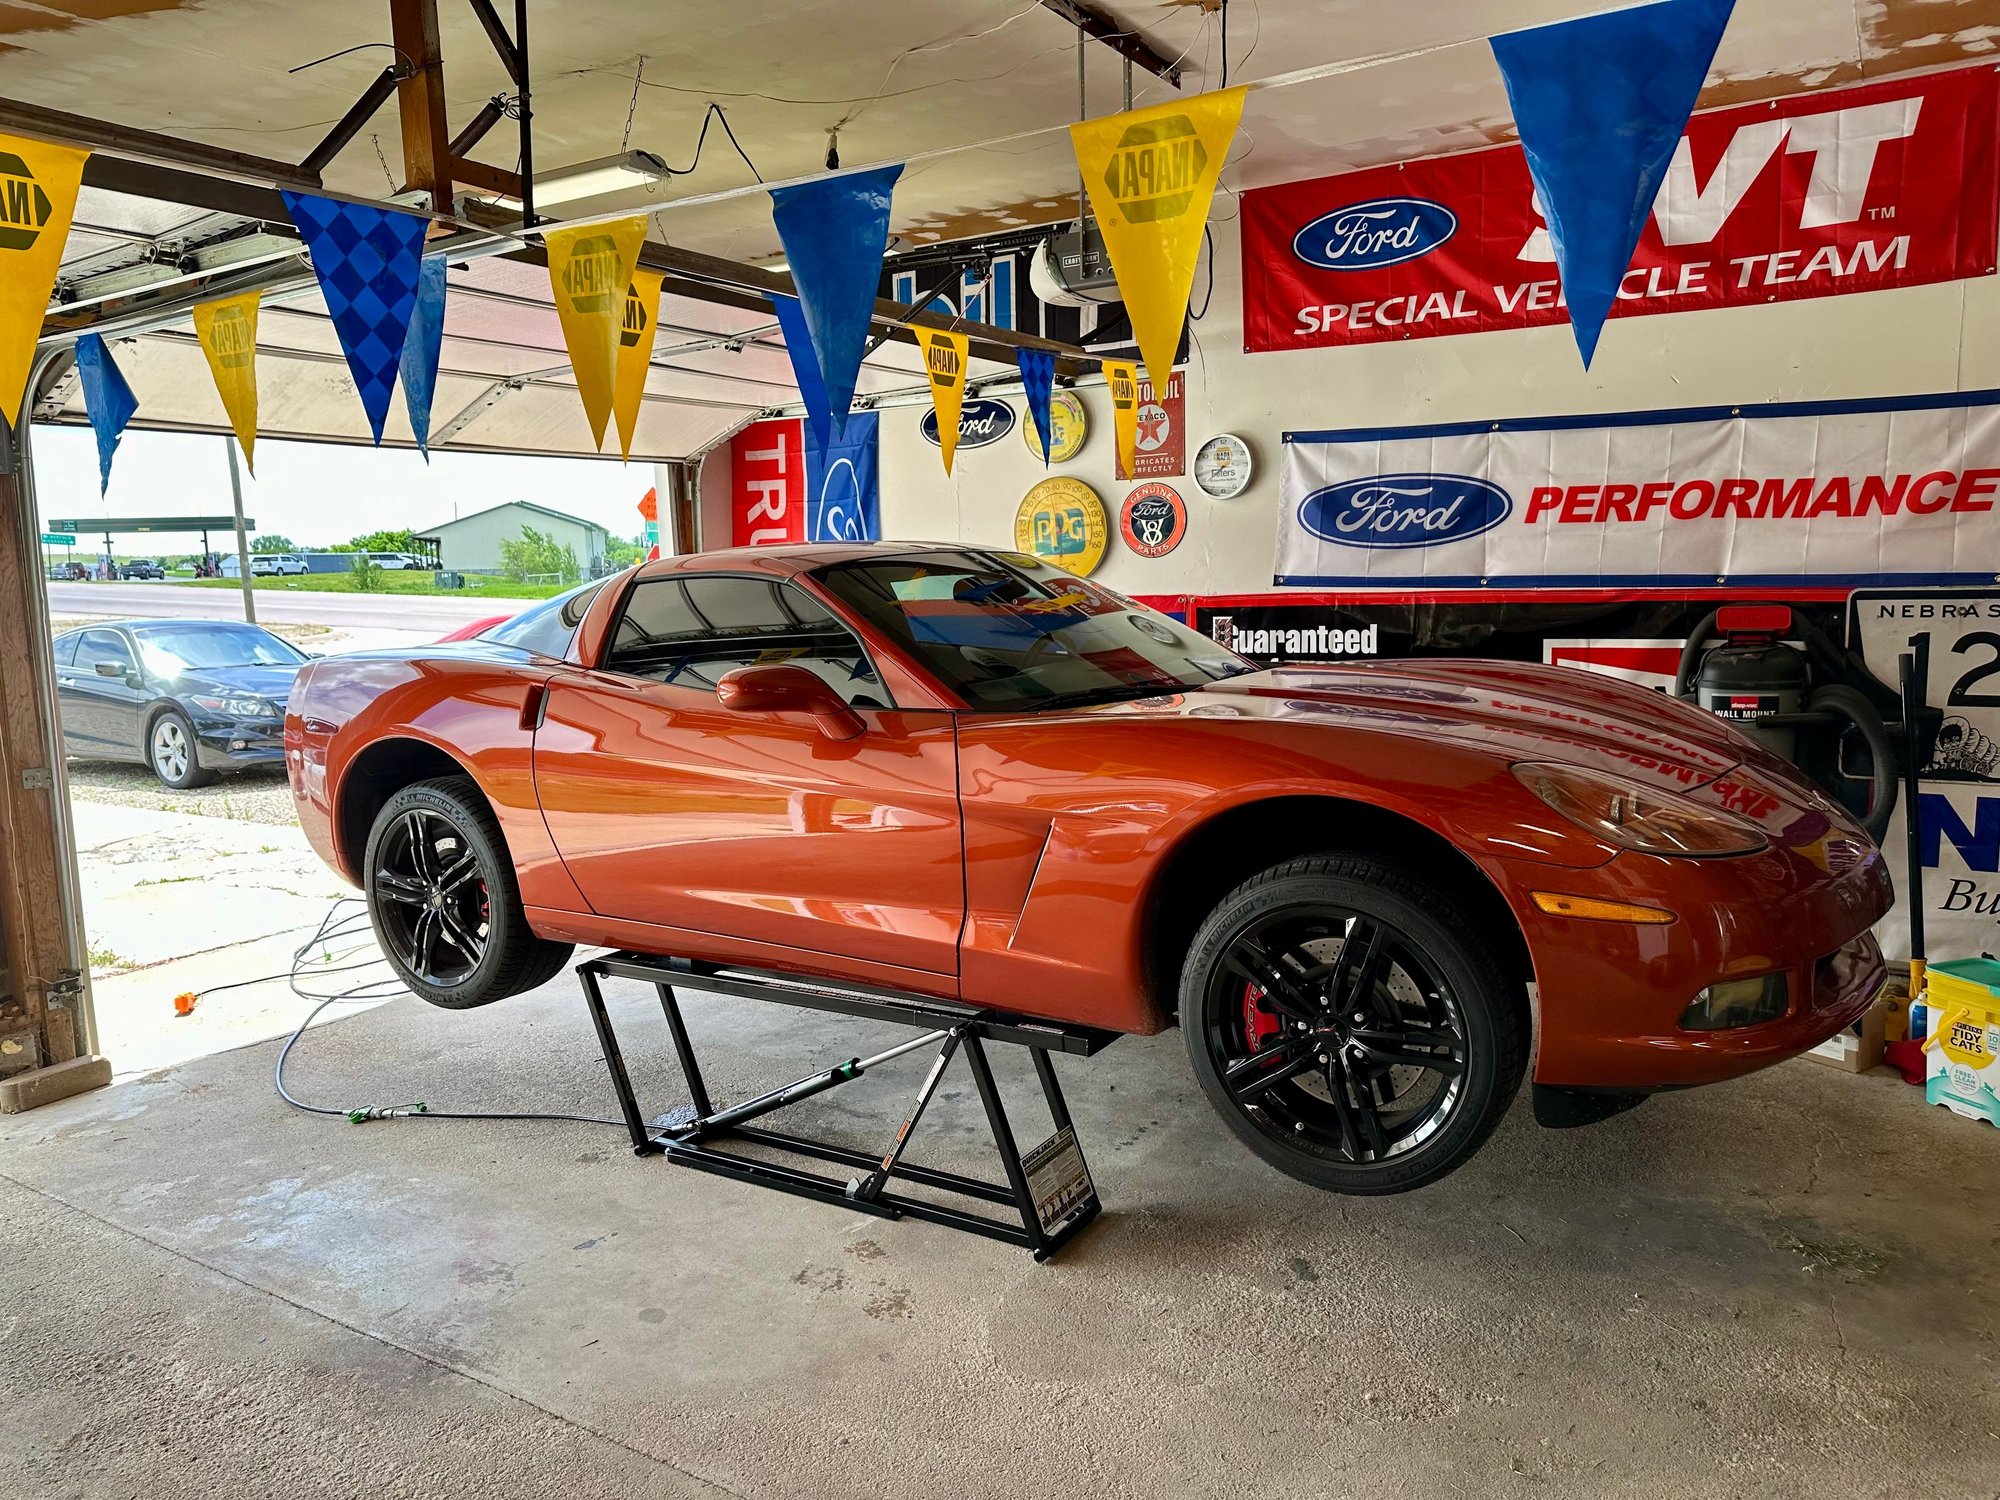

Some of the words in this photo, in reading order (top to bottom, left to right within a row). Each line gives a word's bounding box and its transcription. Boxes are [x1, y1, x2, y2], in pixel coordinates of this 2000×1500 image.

[1868, 206, 1896, 221] TM
[1325, 208, 1421, 260] Ford
[1293, 290, 1478, 336] SPECIAL
[1493, 262, 1711, 314] VECLE
[1730, 235, 1911, 290] TEAM
[957, 405, 997, 438] ord
[1133, 464, 1173, 473] ERFECTLY
[1135, 456, 1175, 466] BRICATES
[1130, 486, 1173, 503] GENUINE
[1333, 485, 1464, 533] Ford
[1523, 468, 1998, 525] PERFORMANCE
[1133, 501, 1170, 516] Ford
[1037, 508, 1083, 548] PPG
[1137, 543, 1169, 555] PARTS
[1715, 710, 1739, 718] WALL
[416, 793, 452, 812] MICHELIN
[1938, 878, 2000, 925] Bu
[1209, 901, 1253, 943] MICHELIN
[1246, 984, 1261, 1053] RVETTE
[1951, 1027, 1982, 1044] TIDY
[1989, 1035, 1999, 1043] 10
[1950, 1036, 1982, 1053] CATS
[1954, 1074, 1976, 1085] CLEAN
